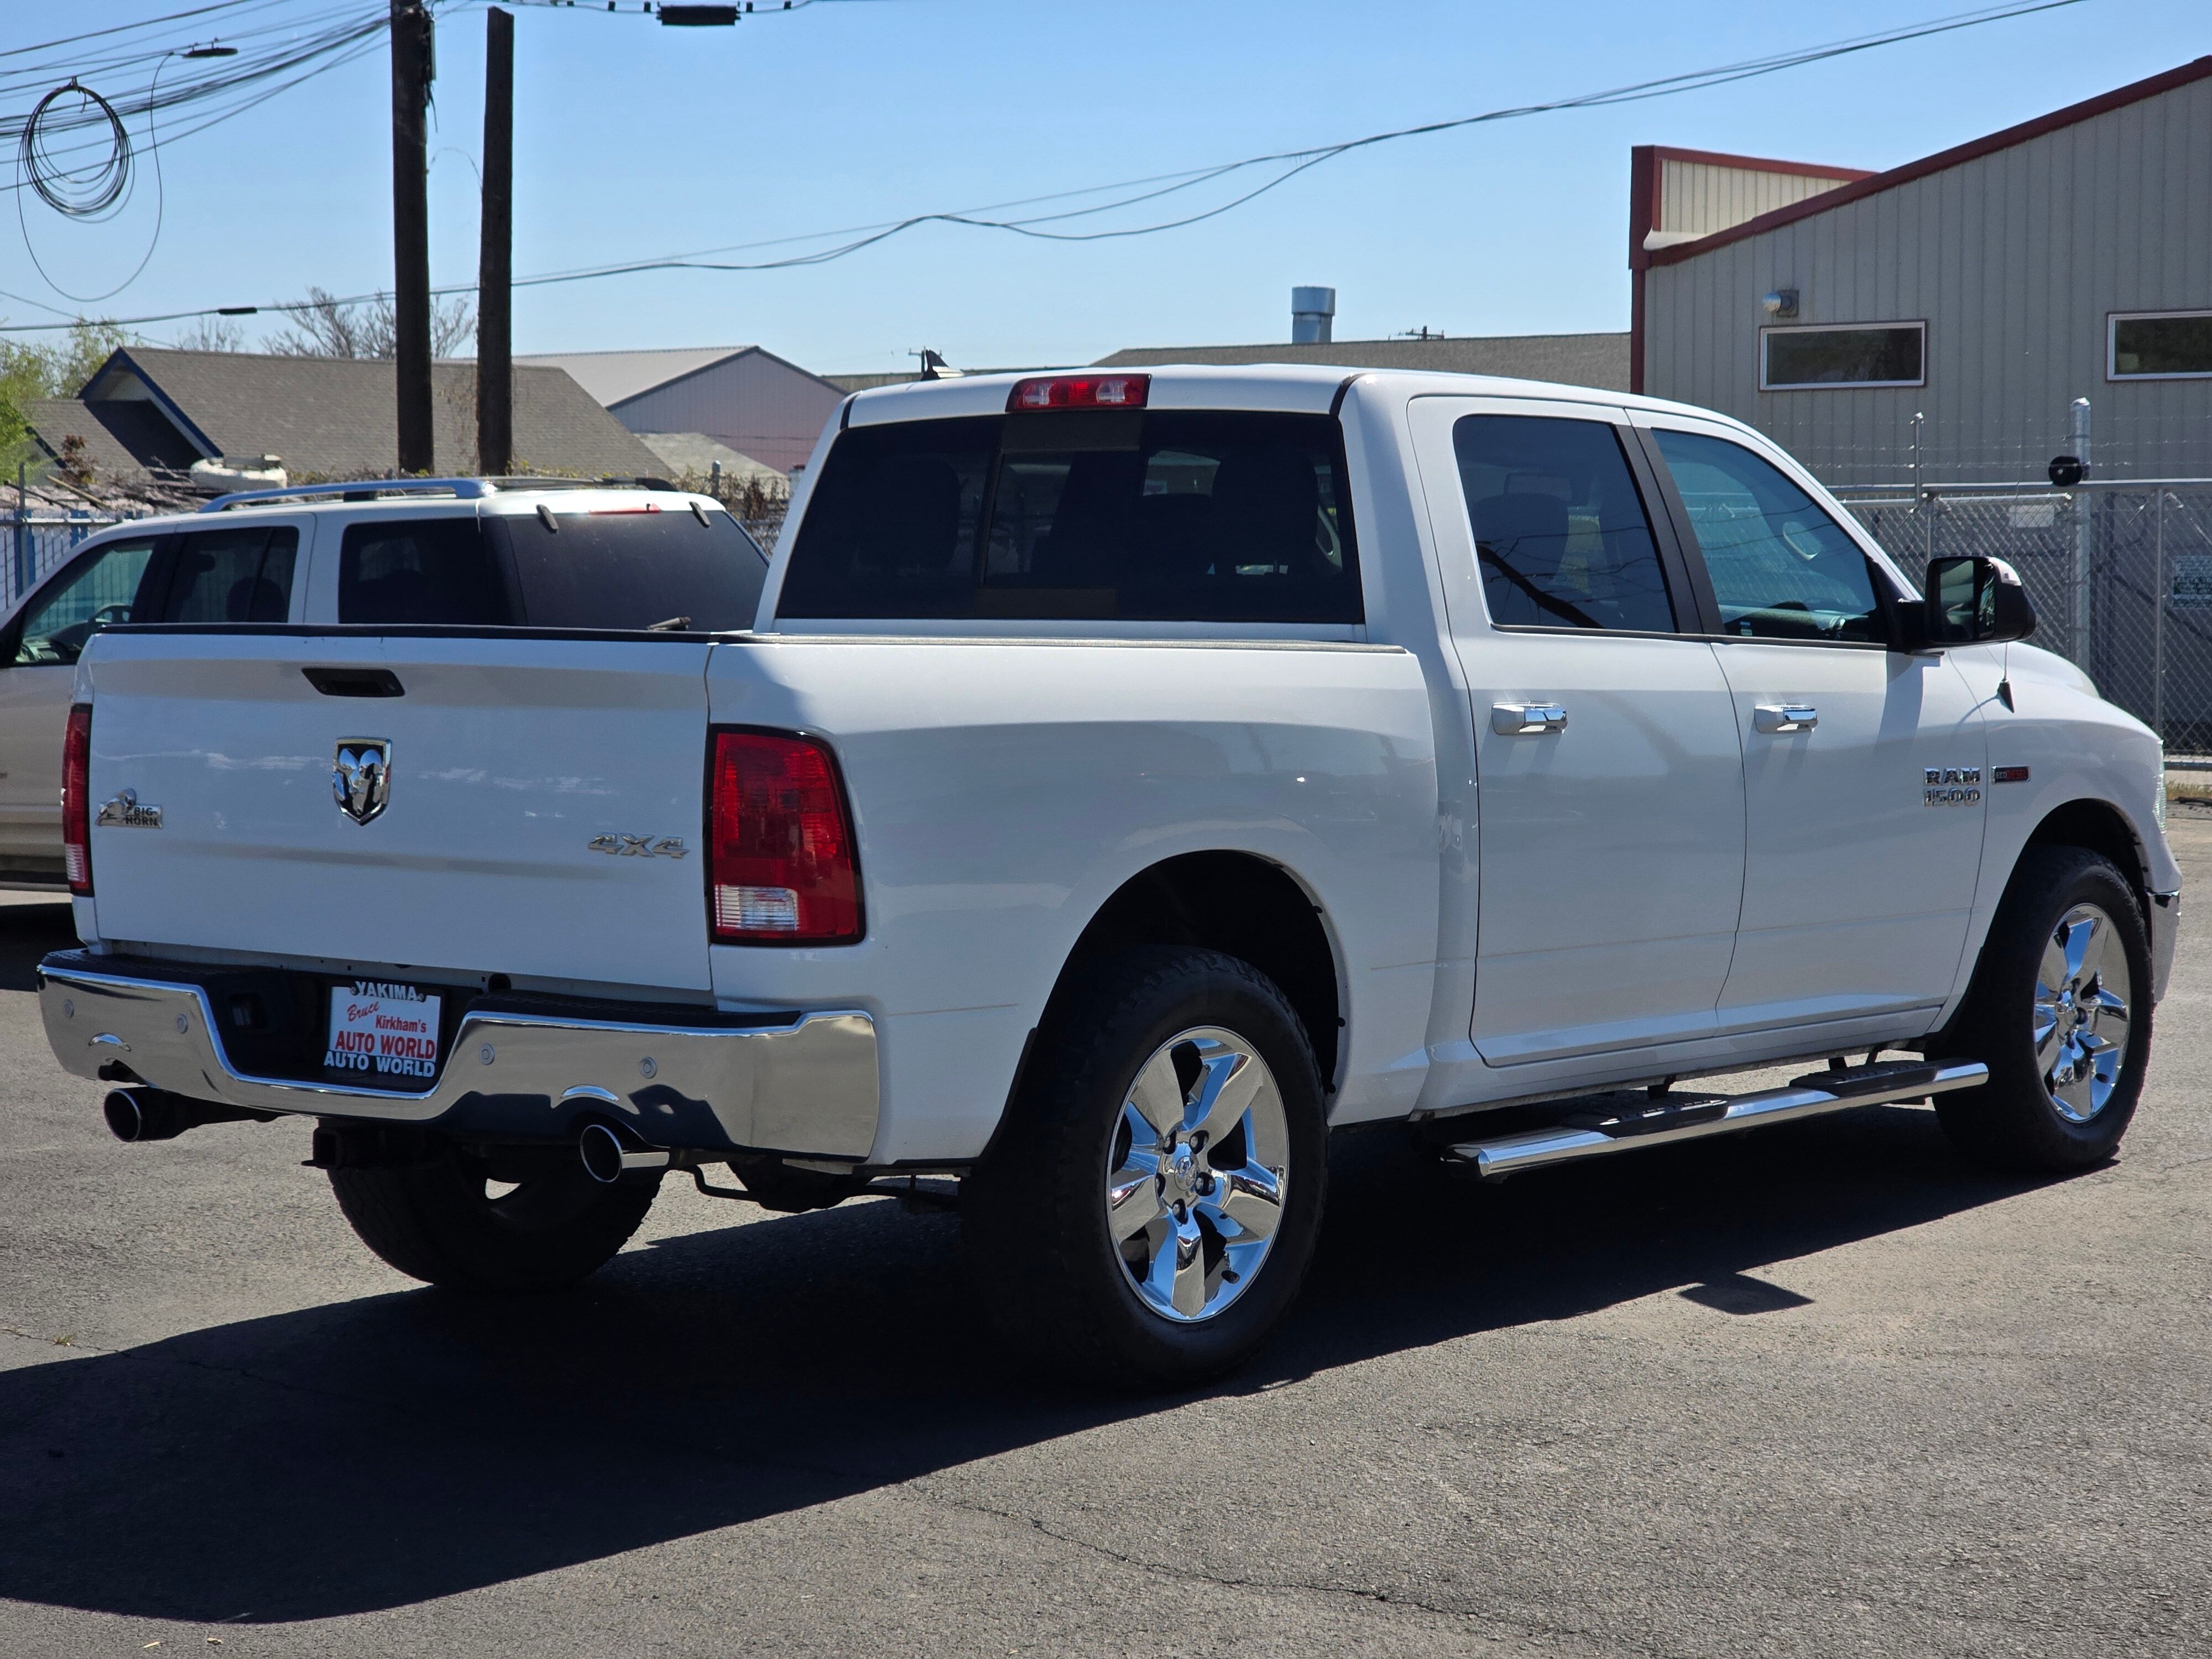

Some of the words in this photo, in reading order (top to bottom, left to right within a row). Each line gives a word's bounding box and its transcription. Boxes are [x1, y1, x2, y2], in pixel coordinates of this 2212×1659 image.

[1923, 767, 1981, 786] RAM
[1923, 787, 1981, 807] 1500
[126, 816, 158, 826] HORN
[134, 807, 154, 816] BIG
[355, 981, 418, 1001] YAKIMA
[347, 1001, 379, 1022] Bruce
[375, 1015, 426, 1033] Kirkham's
[335, 1030, 375, 1053] AUTO
[380, 1035, 436, 1060] WORLD
[324, 1051, 369, 1071] AUTO
[376, 1056, 436, 1078] WORLD
